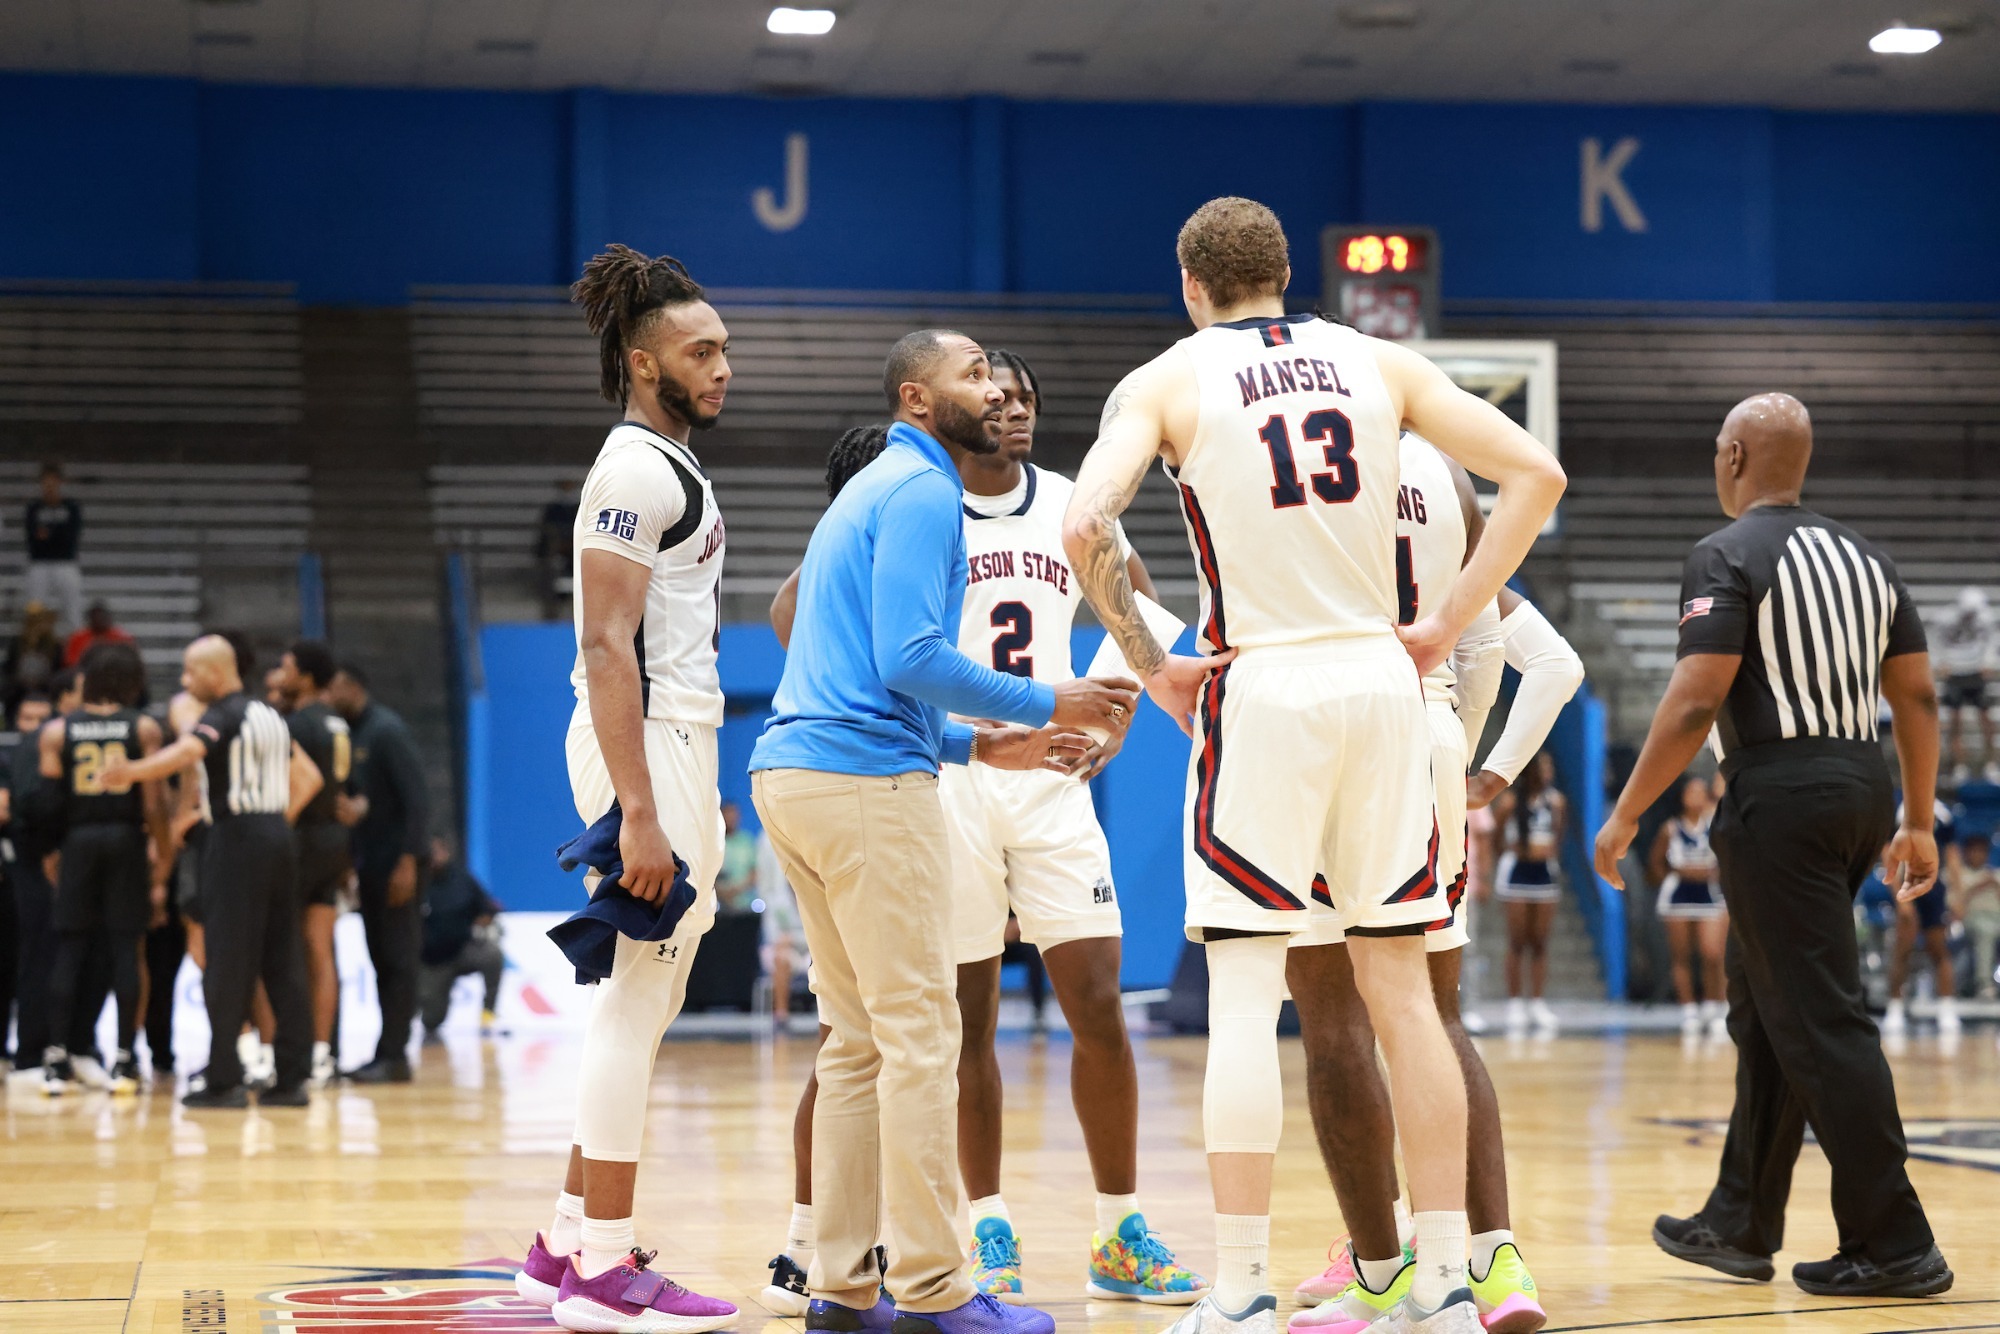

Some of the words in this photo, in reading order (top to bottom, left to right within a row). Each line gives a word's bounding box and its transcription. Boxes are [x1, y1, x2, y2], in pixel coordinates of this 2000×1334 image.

[753, 132, 807, 229] J
[1580, 137, 1646, 230] K
[1235, 358, 1351, 408] MANSEL
[1258, 408, 1361, 509] 13
[1397, 484, 1428, 525] NG
[967, 551, 1014, 585] KSON
[1022, 551, 1068, 595] STATE
[990, 601, 1034, 679] 2
